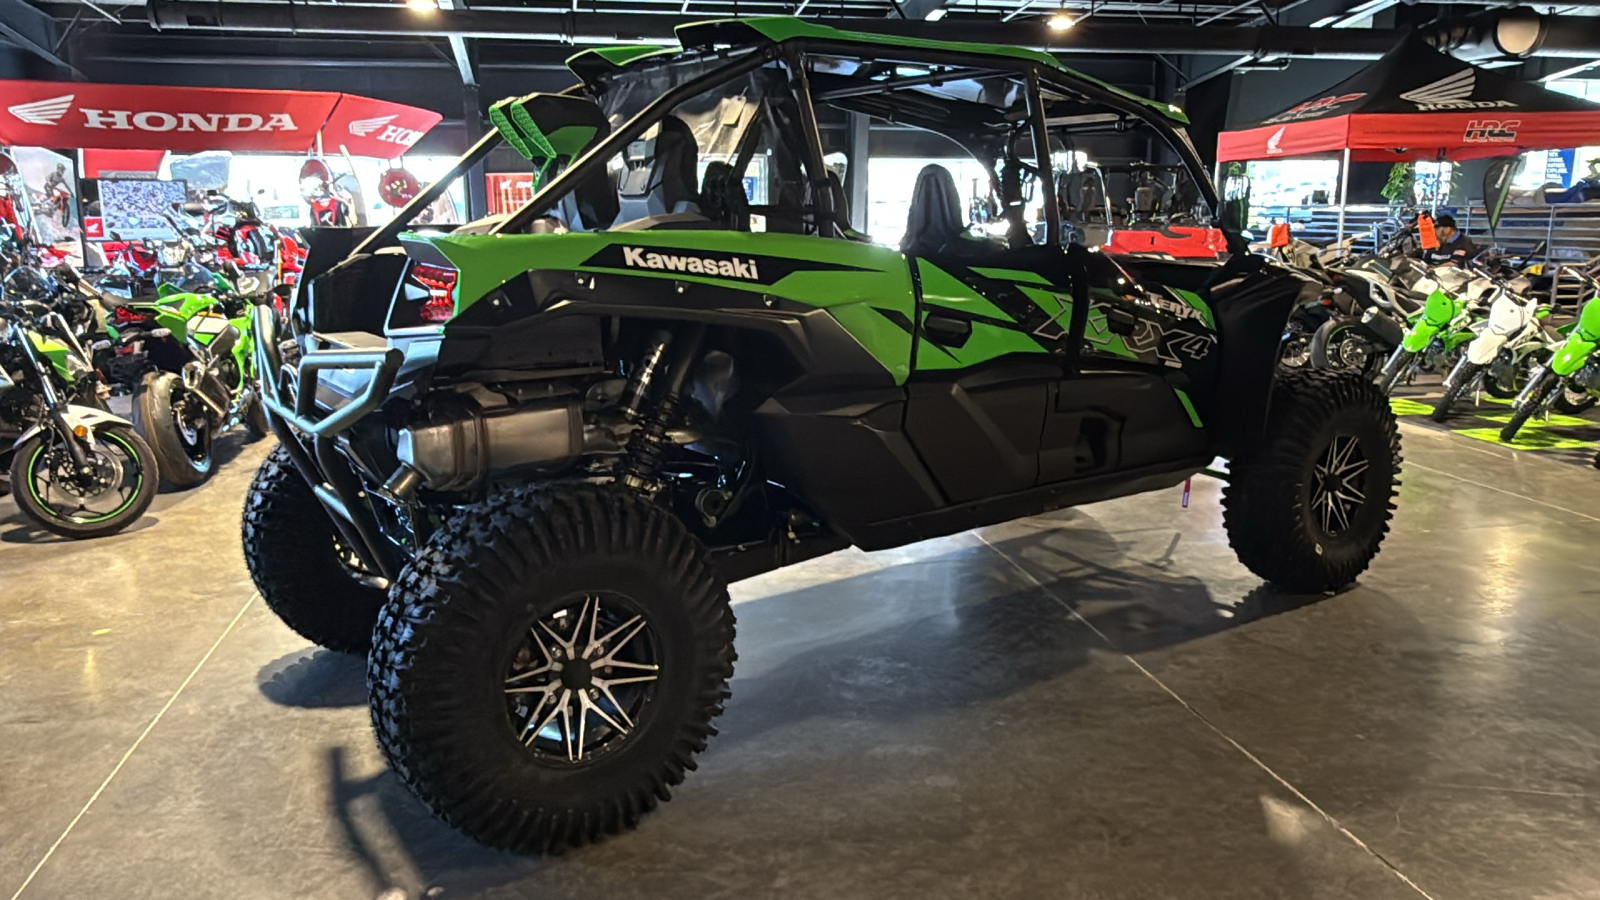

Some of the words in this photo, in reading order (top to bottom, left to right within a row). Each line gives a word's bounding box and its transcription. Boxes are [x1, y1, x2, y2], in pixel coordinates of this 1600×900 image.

[1415, 100, 1519, 111] HONDA
[79, 108, 298, 132] HONDA
[1464, 120, 1521, 138] HRC
[622, 246, 759, 280] Kawasaki
